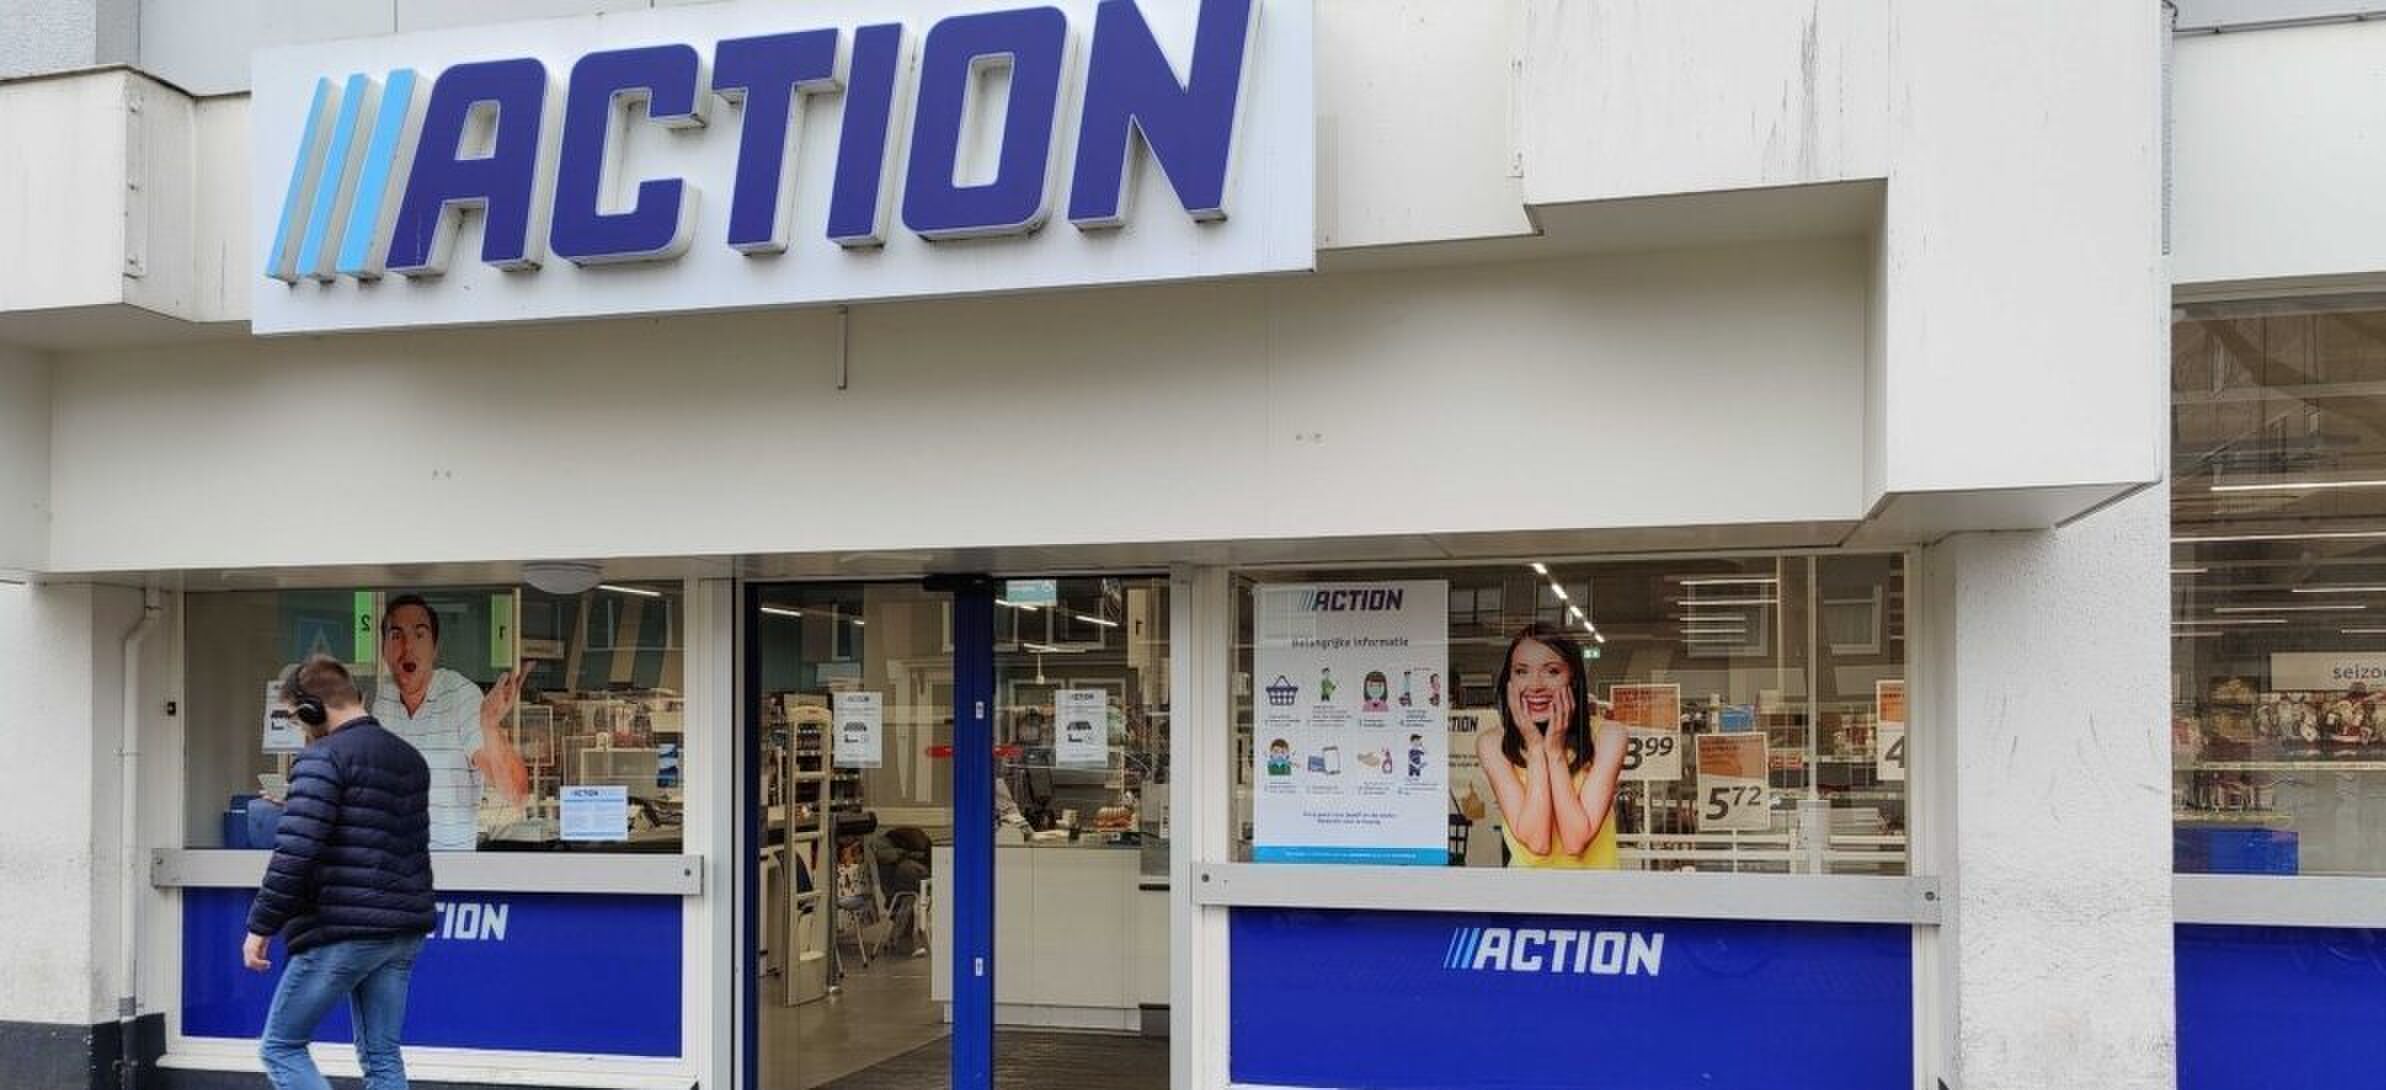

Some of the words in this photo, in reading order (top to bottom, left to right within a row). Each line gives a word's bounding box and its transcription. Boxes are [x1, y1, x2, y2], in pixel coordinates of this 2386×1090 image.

[386, 0, 1254, 276] ACTION
[1312, 588, 1404, 611] ACTION
[2333, 663, 2386, 679] seizo
[1448, 715, 1479, 732] TION
[1472, 927, 1665, 976] ACTION
